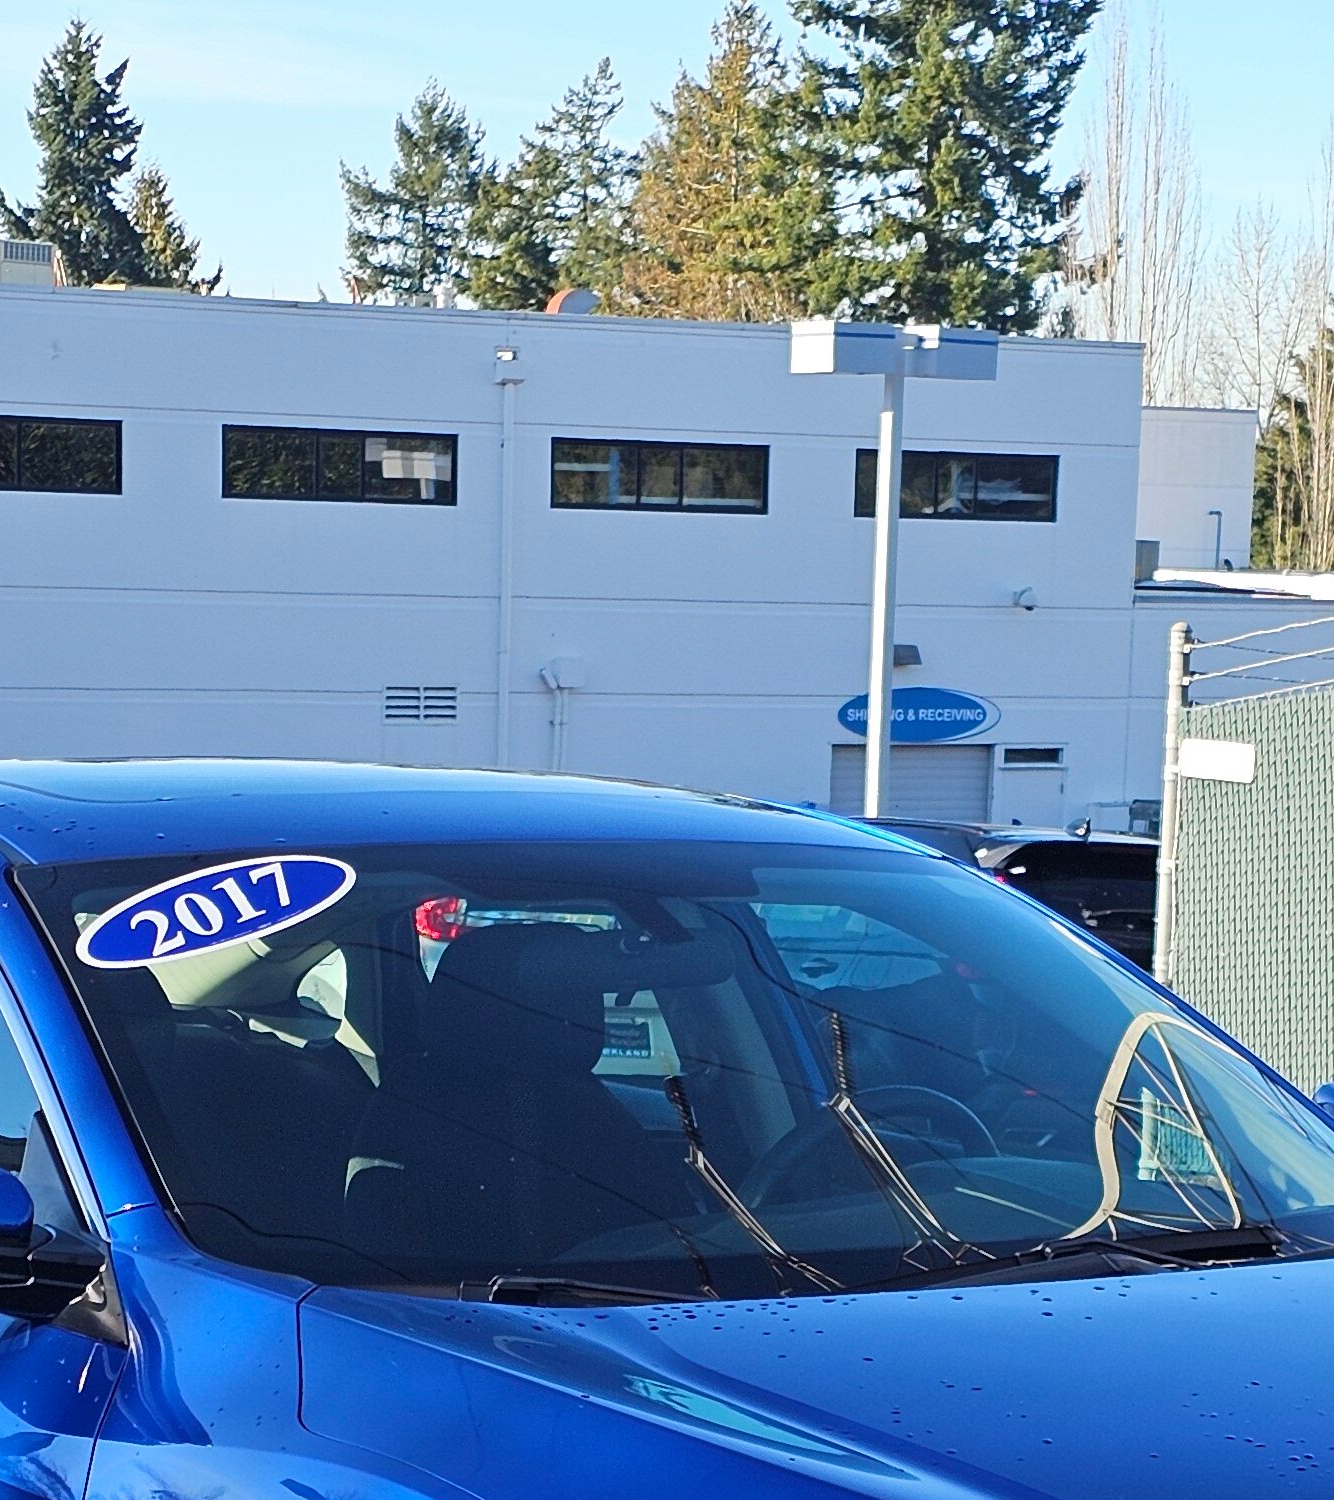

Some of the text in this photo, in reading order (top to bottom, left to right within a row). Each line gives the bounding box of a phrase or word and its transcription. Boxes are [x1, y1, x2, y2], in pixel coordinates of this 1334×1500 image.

[847, 708, 984, 721] SHING & RECEIVING
[129, 862, 293, 957] 2017
